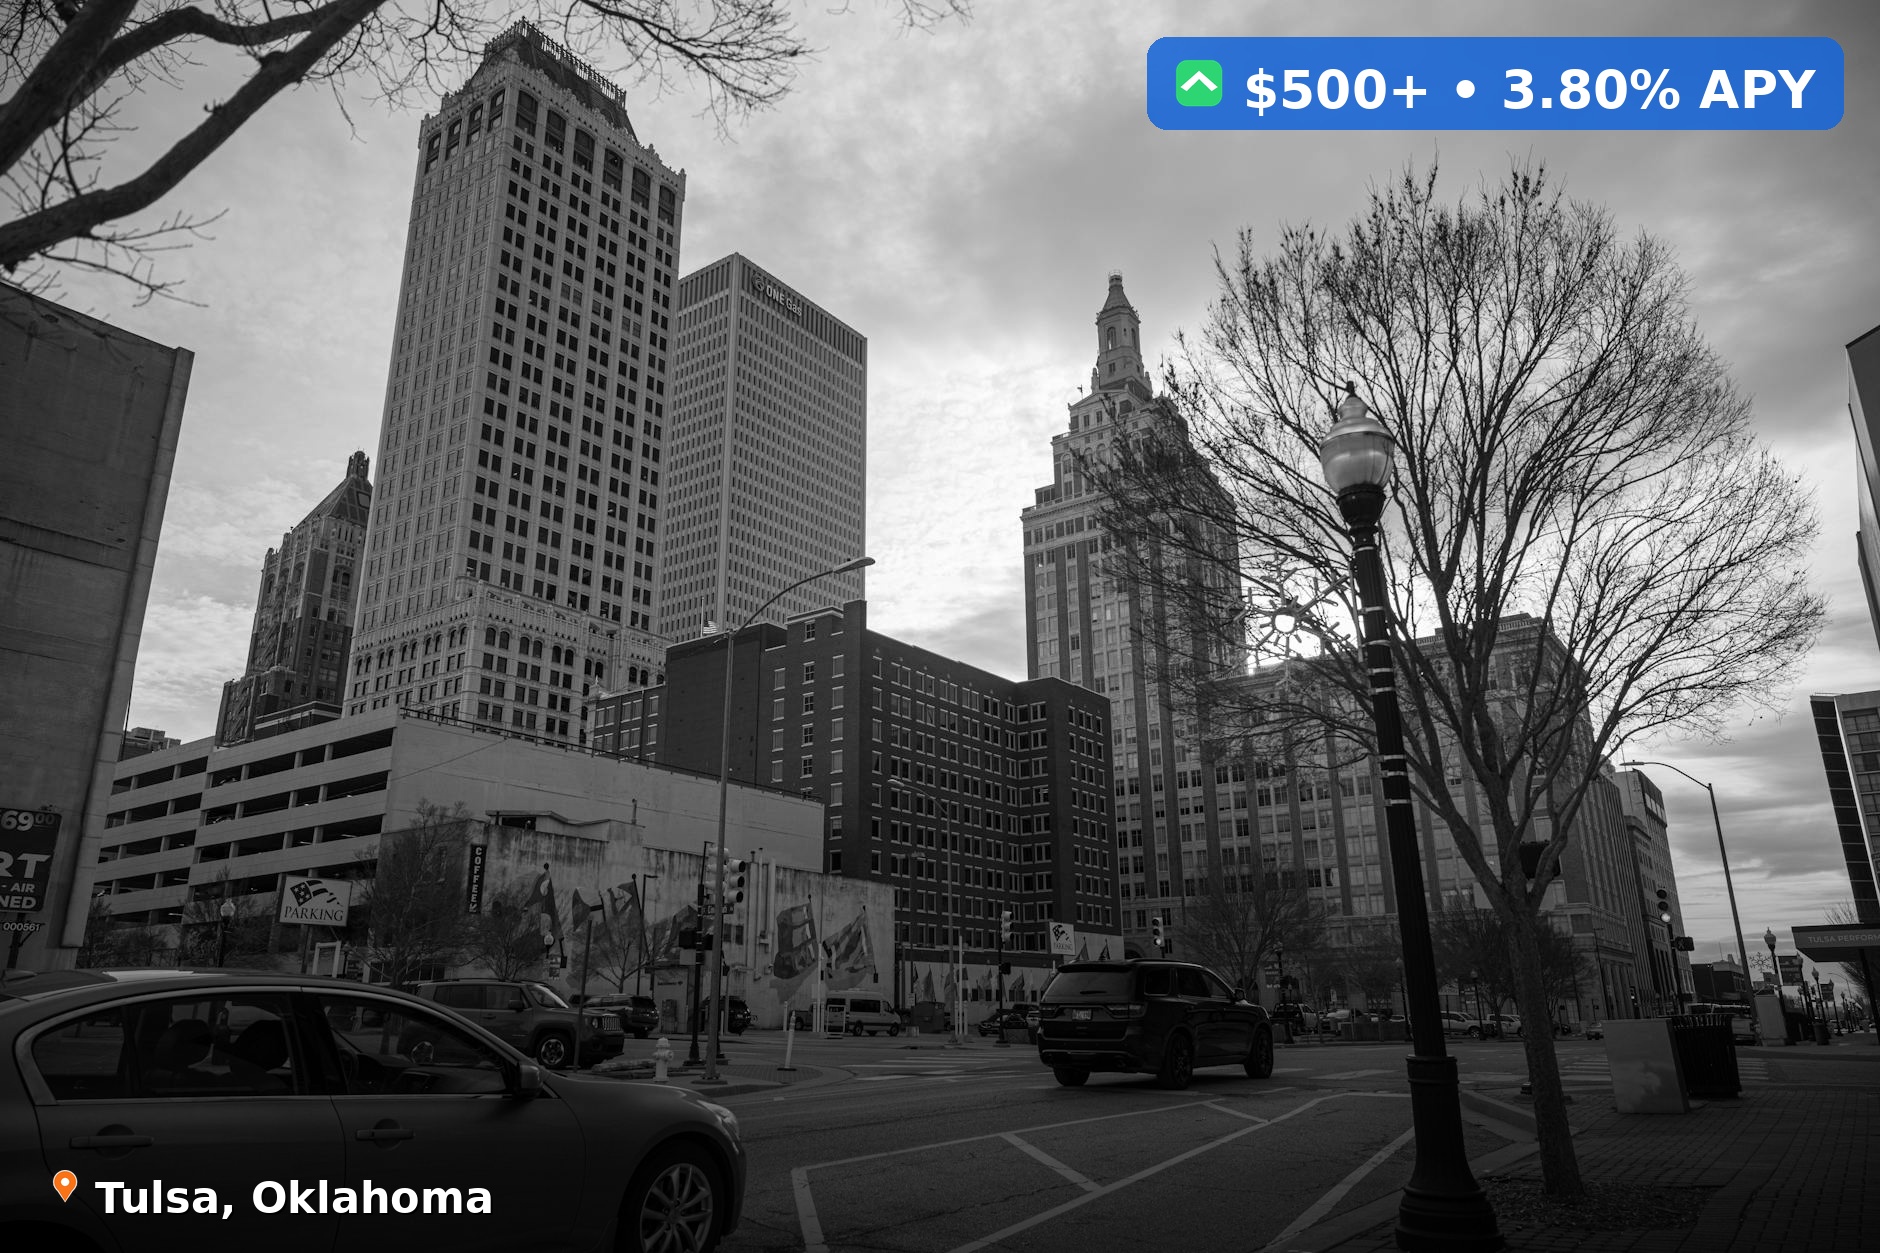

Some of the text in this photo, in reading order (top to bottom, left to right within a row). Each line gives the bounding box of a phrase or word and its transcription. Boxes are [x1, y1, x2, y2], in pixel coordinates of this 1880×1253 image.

[766, 285, 785, 306] ONE
[471, 846, 483, 903] COFFEE
[10, 882, 36, 893] AIR
[284, 906, 344, 922] PARKING
[1807, 936, 1837, 944] TULSA
